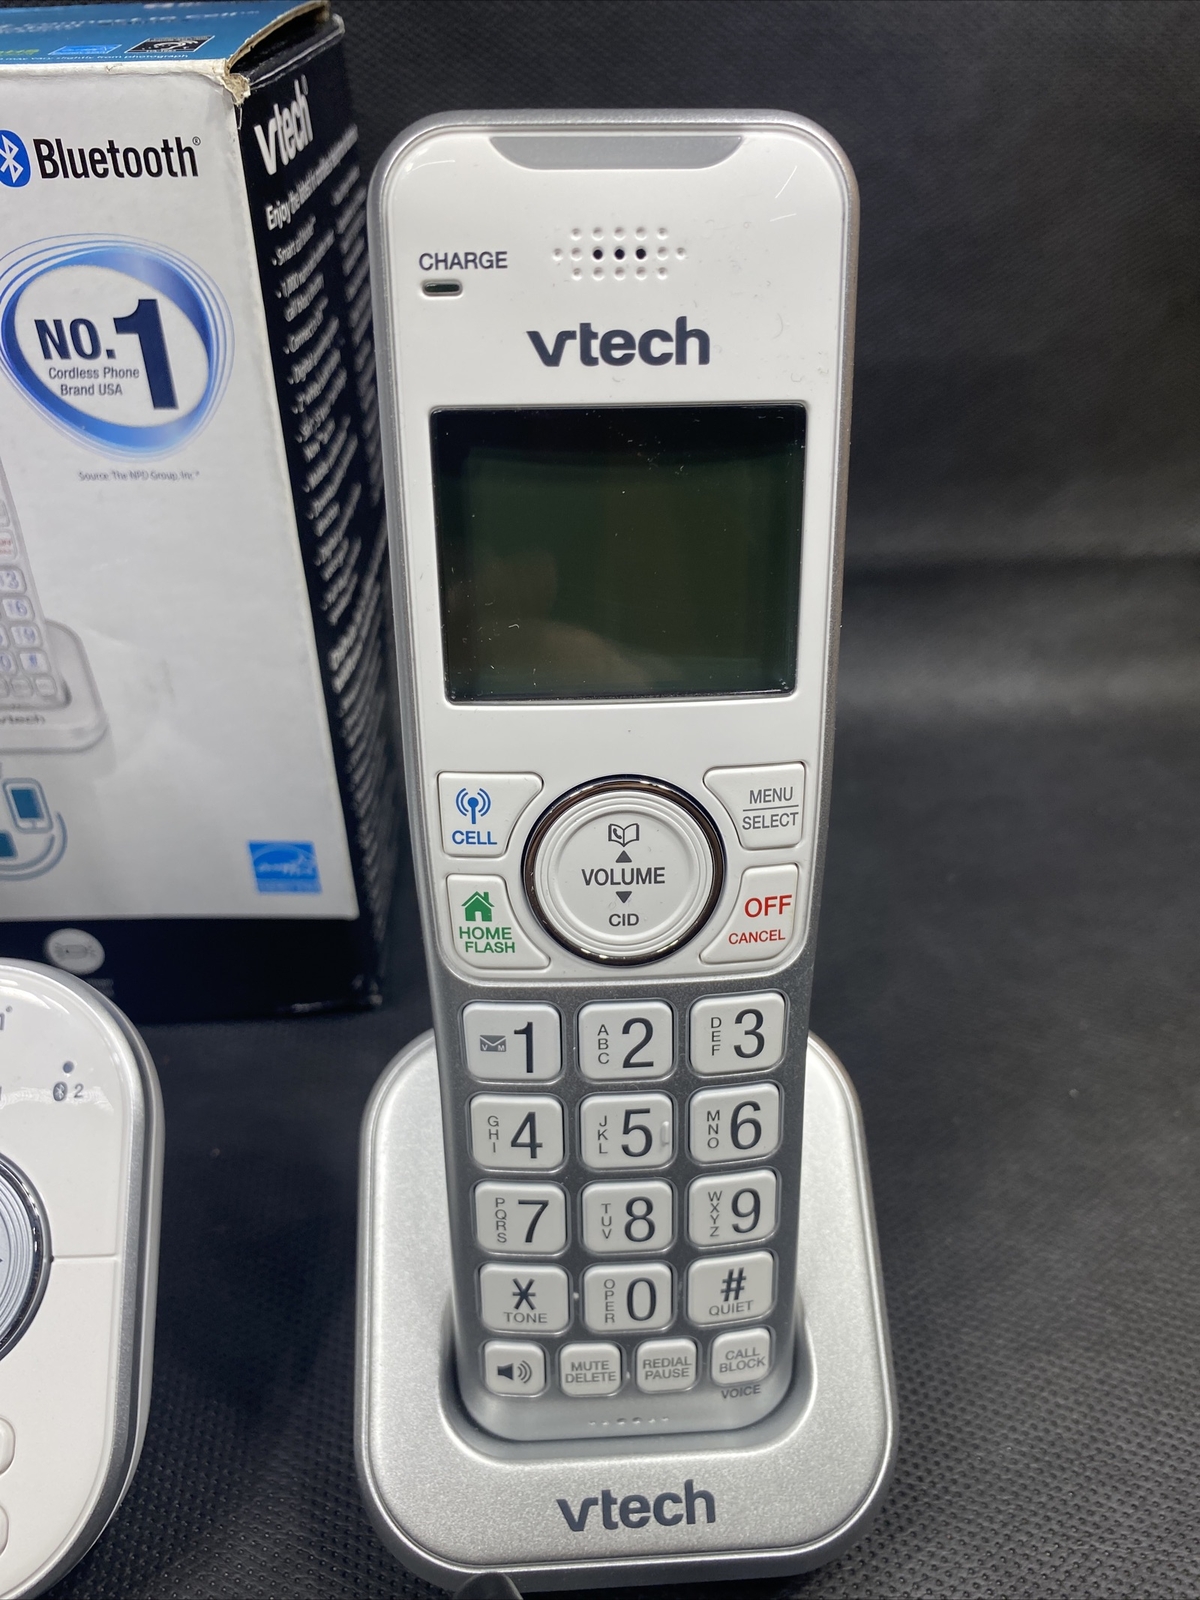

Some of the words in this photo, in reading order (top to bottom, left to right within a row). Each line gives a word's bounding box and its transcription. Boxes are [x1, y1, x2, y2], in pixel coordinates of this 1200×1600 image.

[419, 251, 508, 271] CHARGE
[526, 316, 711, 367] vtech
[33, 318, 117, 360] NO.
[113, 298, 180, 410] 1
[48, 366, 100, 381] Cordless
[102, 366, 140, 380] Phone
[60, 383, 95, 397] Brand
[98, 383, 123, 396] USA
[749, 786, 794, 805] MENU
[741, 811, 800, 831] SELECT
[451, 830, 498, 846] CELL
[580, 867, 666, 887] VOLUME
[744, 894, 794, 919] OFF
[608, 913, 640, 928] CID
[458, 926, 512, 941] HOME
[728, 929, 786, 946] CANCEL
[464, 941, 516, 955] FLASH
[620, 1017, 655, 1069] 2
[732, 1008, 766, 1059] 3
[513, 1021, 535, 1074] 1
[73, 1082, 85, 1099] 2
[510, 1111, 544, 1159] 4
[620, 1107, 653, 1158] 5
[729, 1100, 762, 1151] 6
[623, 1195, 657, 1243] 8
[730, 1187, 762, 1234] 9
[517, 1198, 550, 1244] 7
[719, 1266, 748, 1302] #
[626, 1276, 658, 1322] 0
[707, 1300, 755, 1317] QUIET
[502, 1311, 549, 1325] TONE
[641, 1356, 693, 1370] REDIAL
[718, 1356, 767, 1374] BLOCK
[724, 1350, 761, 1361] CALL
[570, 1360, 610, 1373] MUTE
[643, 1367, 691, 1381] PAUSE
[564, 1371, 618, 1384] DELETE
[720, 1384, 762, 1400] VOICE
[555, 1478, 716, 1533] vtech
